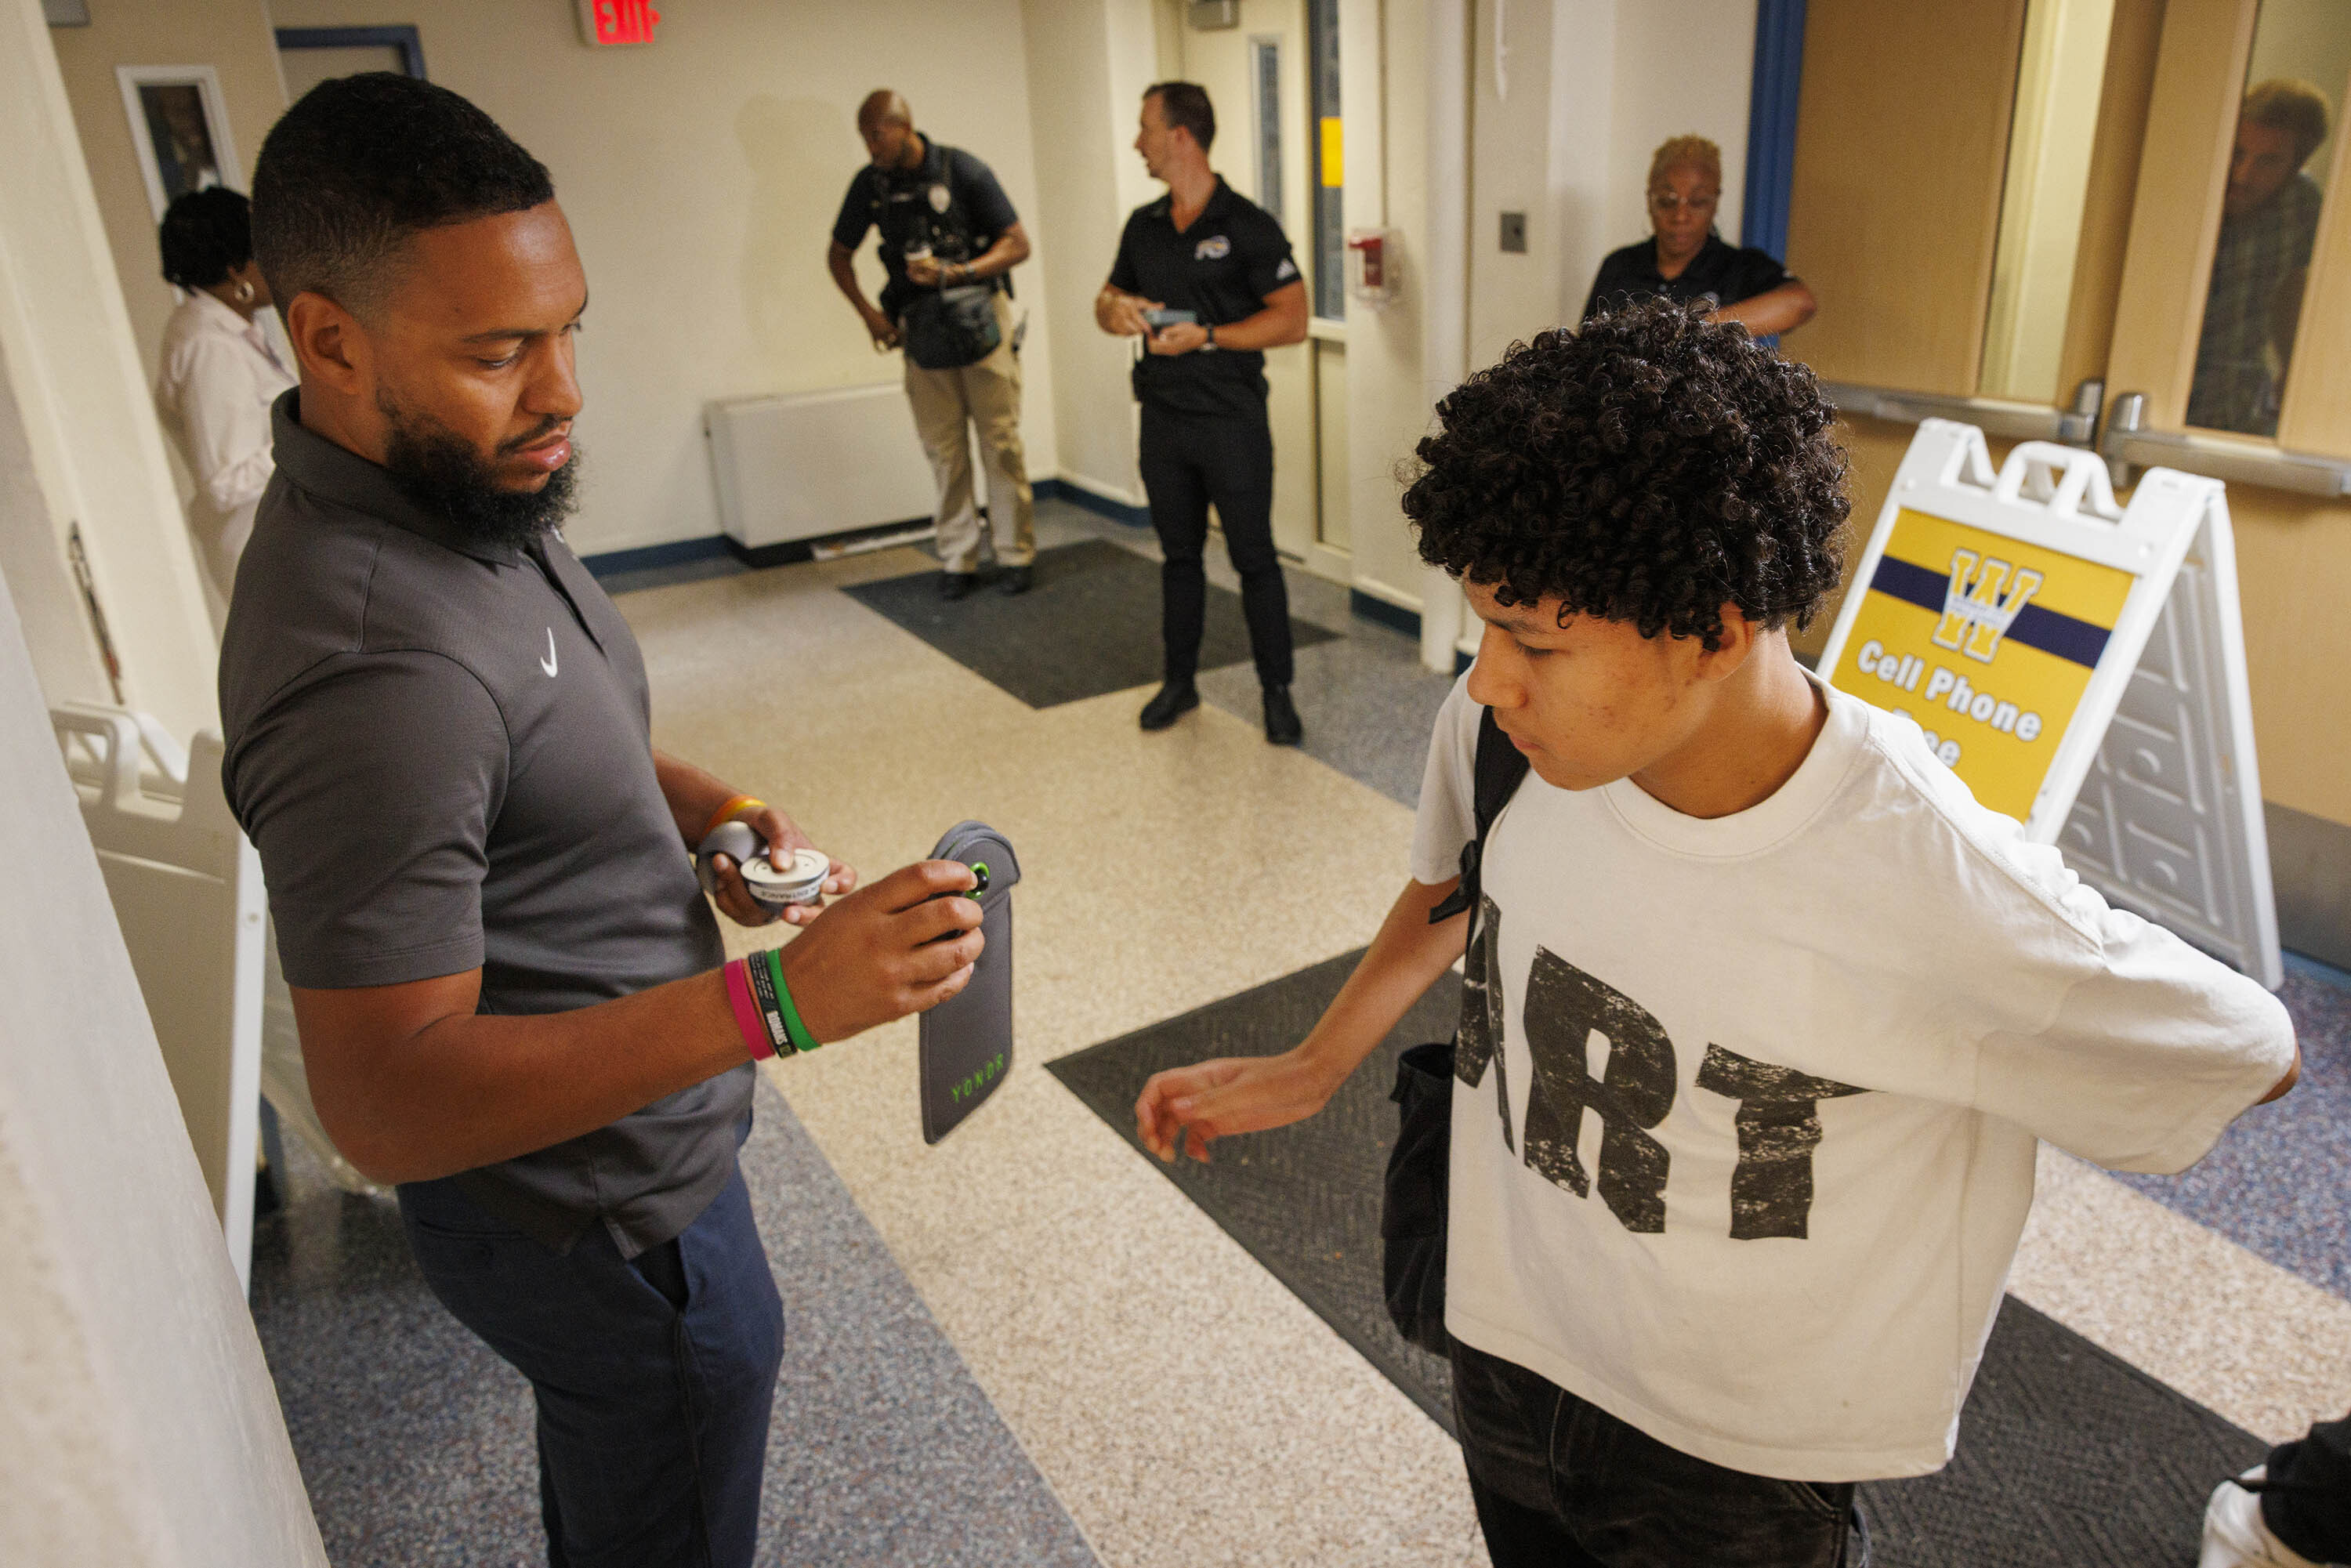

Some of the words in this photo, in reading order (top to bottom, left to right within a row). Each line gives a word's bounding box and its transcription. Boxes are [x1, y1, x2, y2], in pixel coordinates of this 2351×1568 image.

[1932, 548, 2043, 664] W
[1857, 639, 1924, 693] Cell
[1924, 665, 2042, 742] Phone
[951, 1053, 1004, 1104] YONDR
